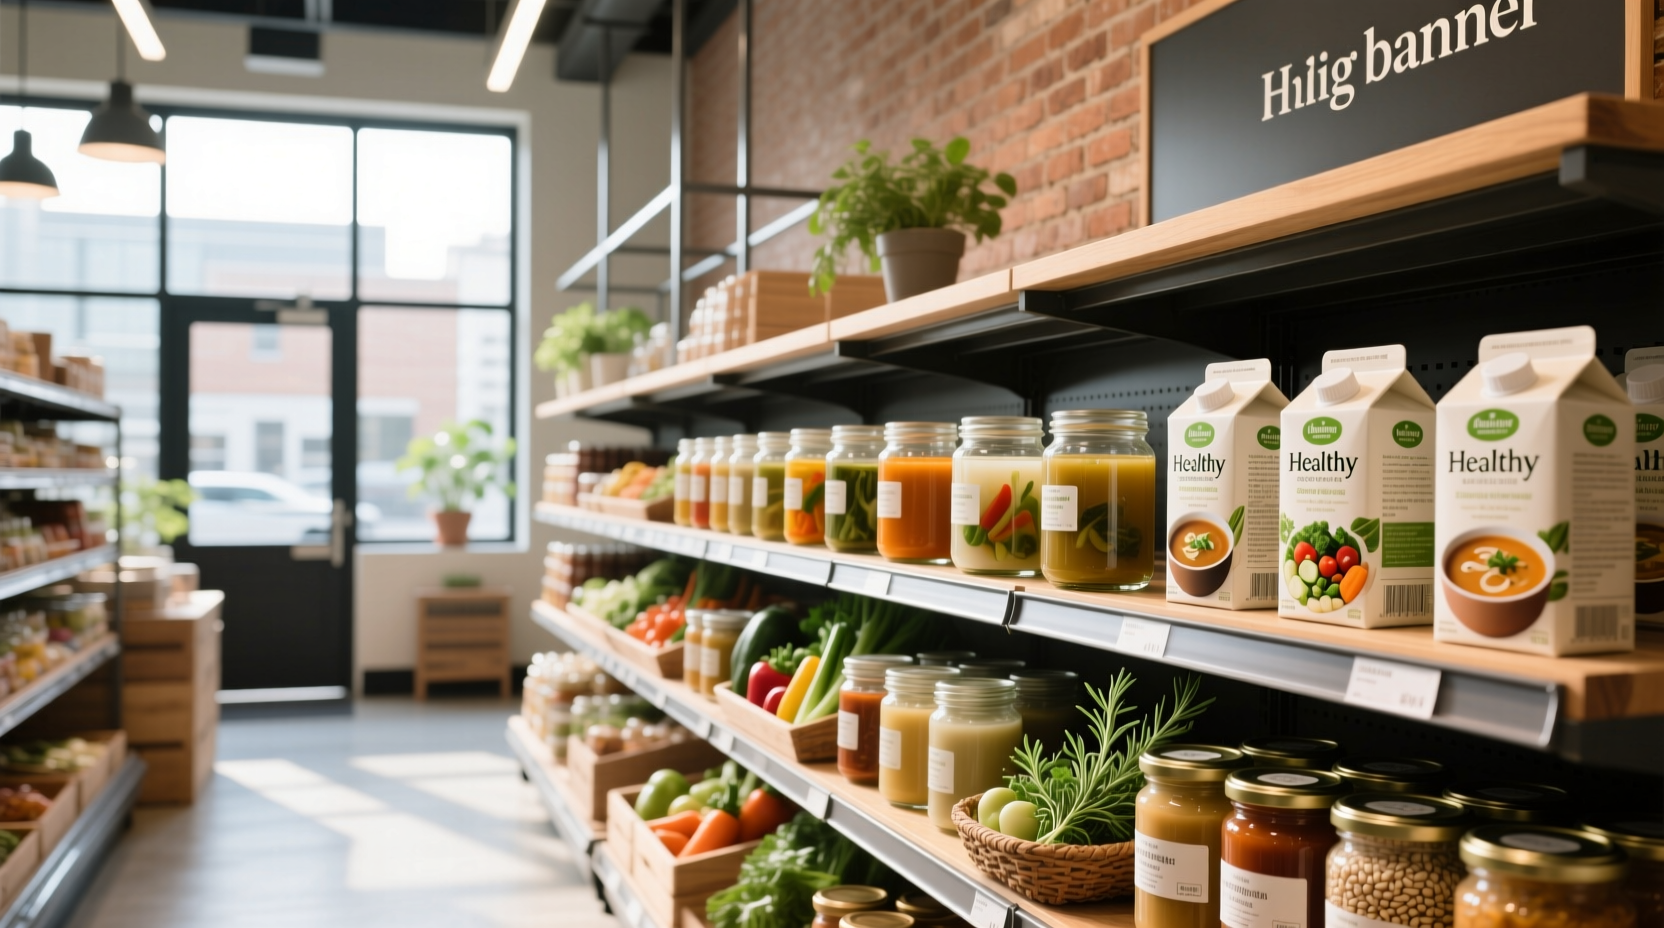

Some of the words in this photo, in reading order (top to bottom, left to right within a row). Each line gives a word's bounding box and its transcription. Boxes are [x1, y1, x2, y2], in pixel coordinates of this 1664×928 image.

[1173, 453, 1226, 479] Healthy
[1288, 451, 1358, 480] Healthy
[1448, 448, 1540, 482] Healthy
